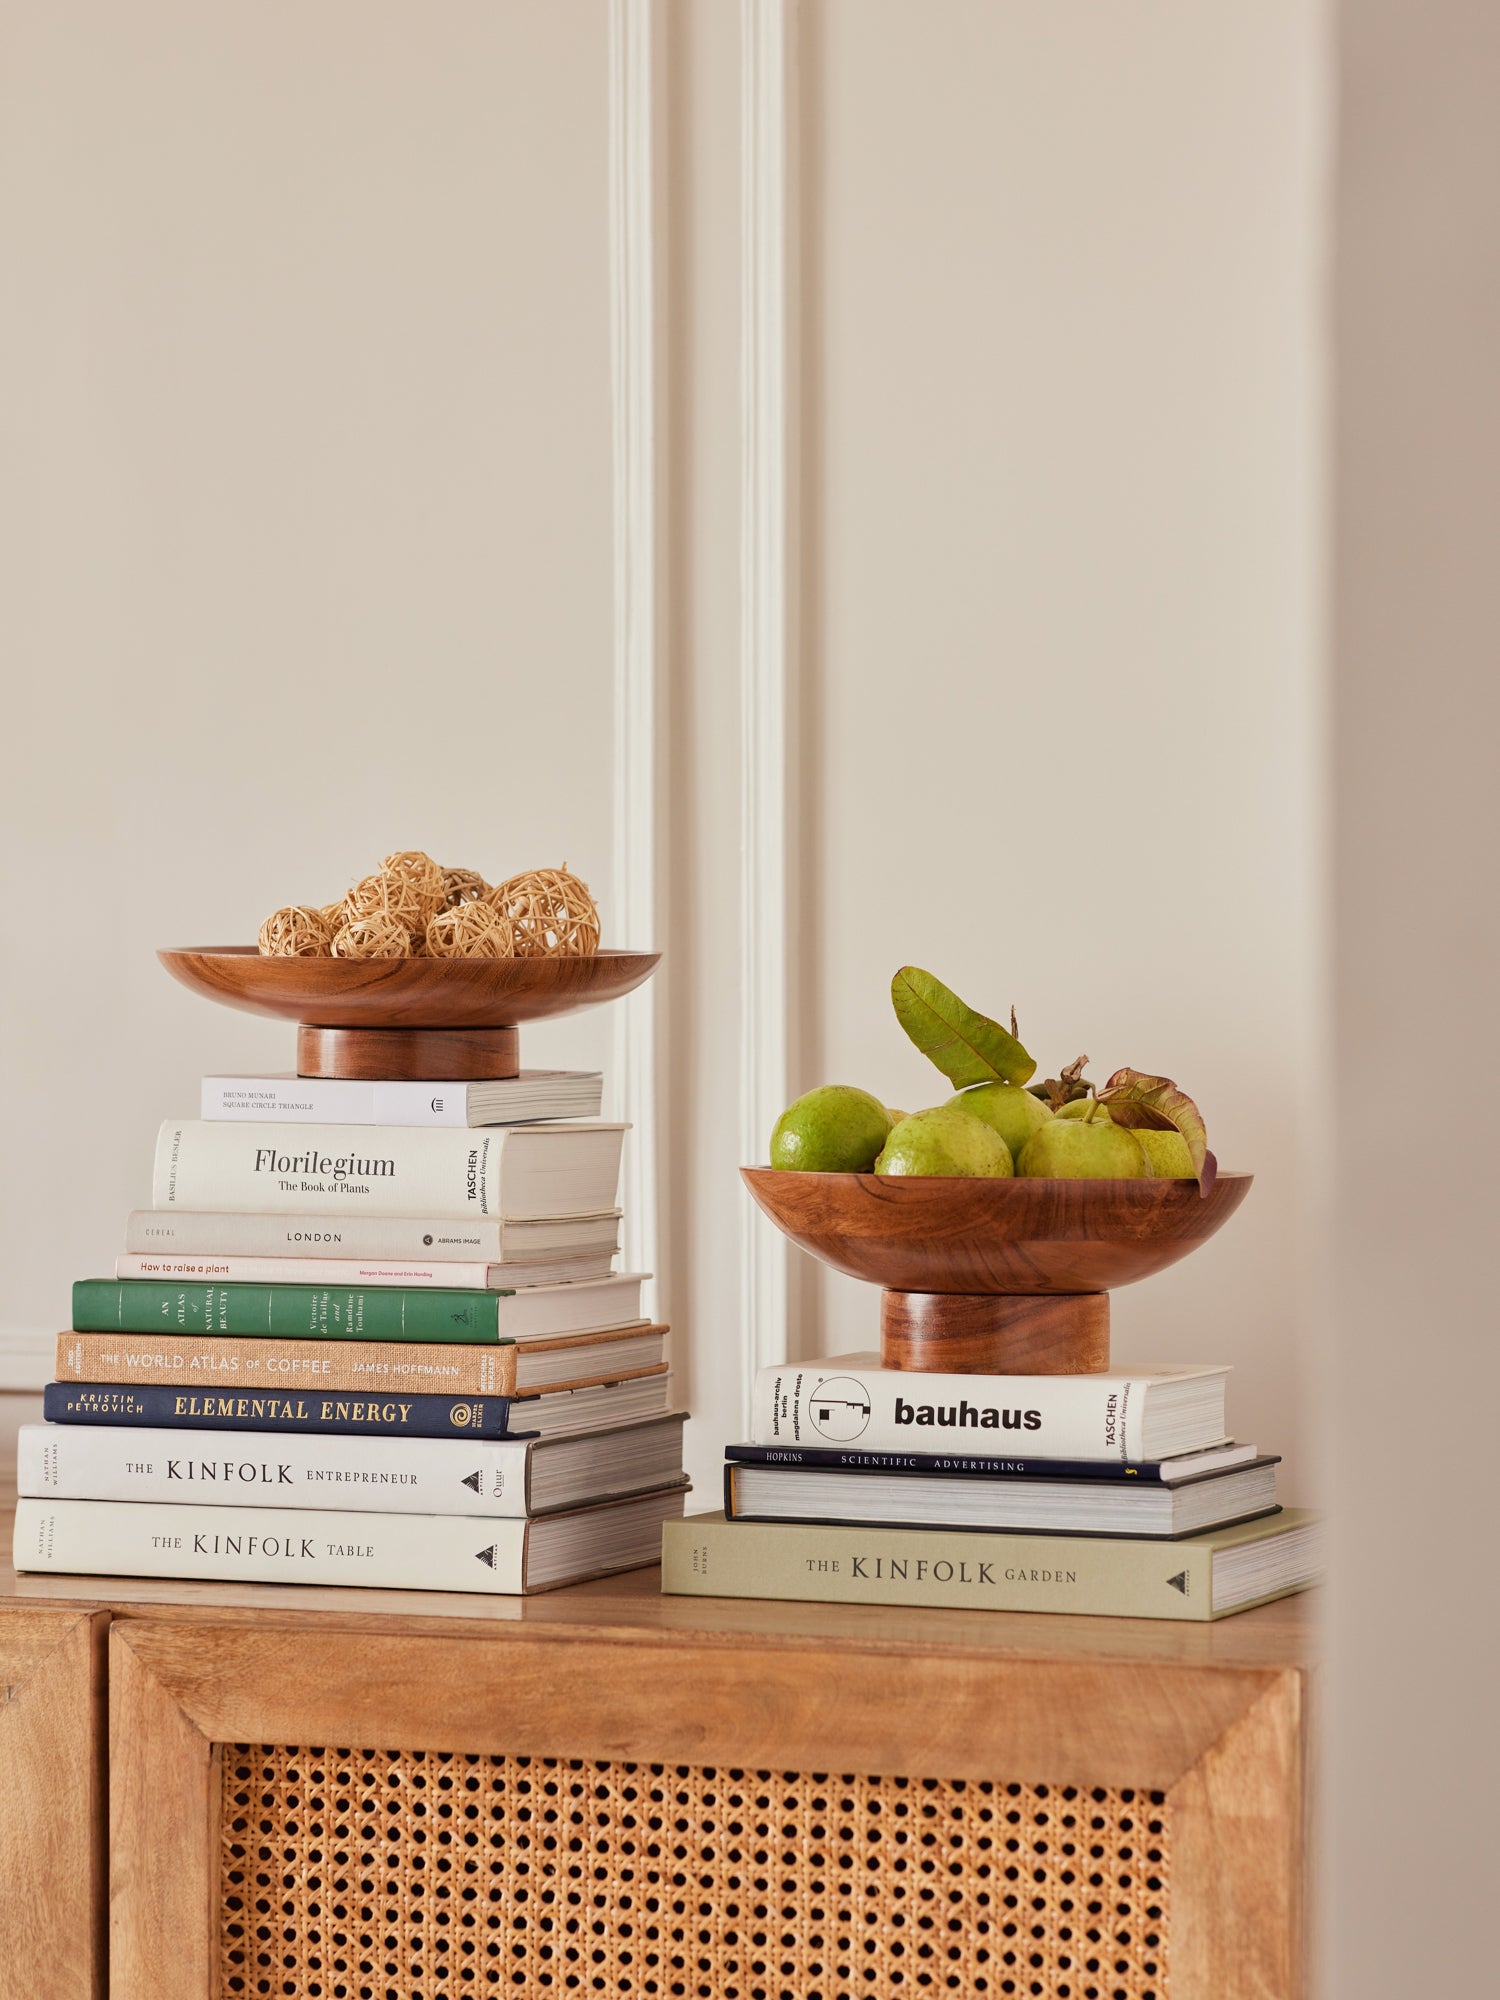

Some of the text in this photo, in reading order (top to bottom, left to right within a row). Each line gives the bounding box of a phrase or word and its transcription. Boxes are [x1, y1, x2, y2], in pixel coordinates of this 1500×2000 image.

[223, 1101, 250, 1109] SQUARE
[253, 1149, 396, 1181] Florilegium
[467, 1150, 478, 1201] TASCHEN
[278, 1180, 370, 1193] The Book of Plants
[145, 1228, 175, 1237] CEREAL
[287, 1232, 342, 1242] LONDON
[140, 1262, 160, 1271] How
[162, 1263, 172, 1272] to
[173, 1263, 196, 1272] raise
[205, 1264, 229, 1275] plant
[162, 1301, 169, 1317] AN
[177, 1293, 186, 1326] ATLAS
[205, 1286, 215, 1331] NATURAL
[219, 1290, 228, 1330] BEAUTY
[332, 1303, 341, 1322] and
[100, 1354, 331, 1374] THE WORLD ATLAS OF COFFEE
[352, 1362, 459, 1377] JAMES HOFFMANN
[67, 1402, 143, 1414] PETROVICH
[80, 1393, 134, 1404] KRISTIN
[174, 1396, 412, 1423] ELEMENTAL ENERGY
[772, 1377, 782, 1436] bauhaus-archiv
[792, 1373, 803, 1441] magdalena droste
[894, 1397, 1042, 1431] bauhaus
[1105, 1394, 1118, 1447] TASCHEN
[766, 1452, 803, 1462] HOPKINS
[841, 1455, 1025, 1472] SCIENTIFIC ADVERTISING
[126, 1460, 418, 1485] THE KINFOLK ENTREPRENEUR
[38, 1519, 46, 1555] NATHAN
[152, 1534, 375, 1558] THE KINFOLK TABLE
[806, 1557, 1077, 1585] THE KINFOLK GARDEN
